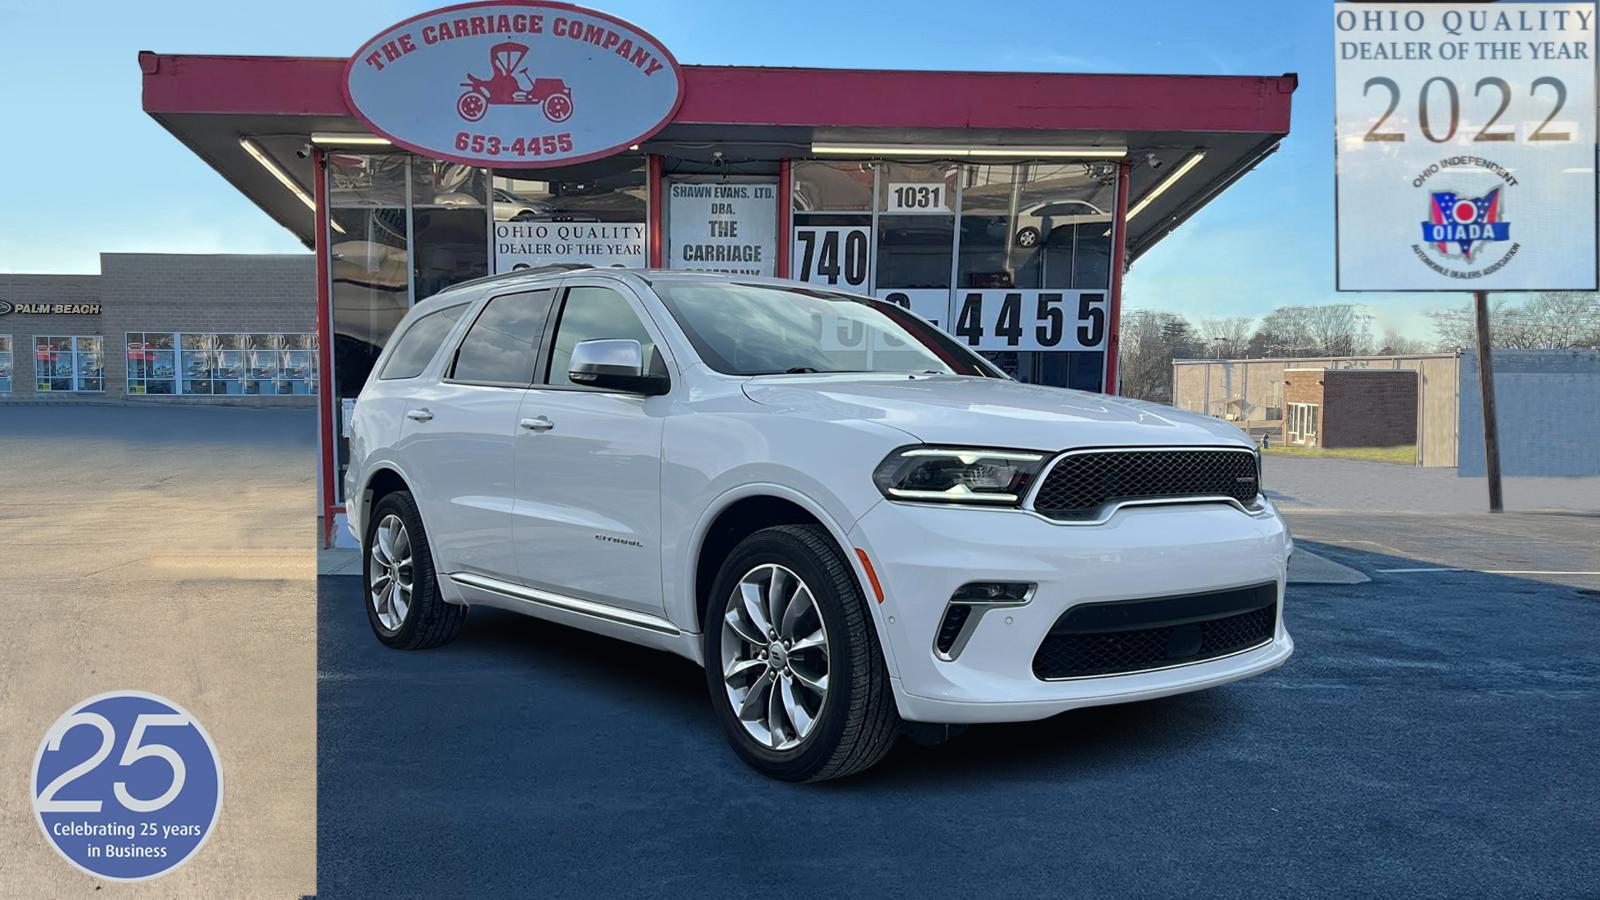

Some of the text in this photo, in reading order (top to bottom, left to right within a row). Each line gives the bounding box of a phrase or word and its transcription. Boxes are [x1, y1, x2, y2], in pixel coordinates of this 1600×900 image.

[1336, 10, 1592, 35] OHIO QUALITY
[366, 14, 664, 77] THE CARRIAGE COMPANY
[1340, 42, 1589, 60] DEALER OF THE YEAR
[1363, 76, 1571, 143] 2022
[455, 132, 573, 156] 653-4455
[1412, 156, 1519, 188] OHIO INDEPENDENT
[673, 186, 711, 198] SHAWN
[754, 187, 774, 199] LTD.
[895, 187, 940, 208] 1031
[711, 203, 736, 215] DBA.
[497, 226, 644, 241] OHIO QUALITY
[709, 221, 737, 237] THE
[1432, 224, 1495, 241] OIADA
[500, 243, 641, 255] DEALER OF THE YEAR
[683, 244, 762, 262] CARRIAGE
[797, 230, 867, 286] 740
[1411, 242, 1521, 280] AUTOMOBILE DEALERS ASSOCIATION
[15, 303, 100, 314] PALM BEACH
